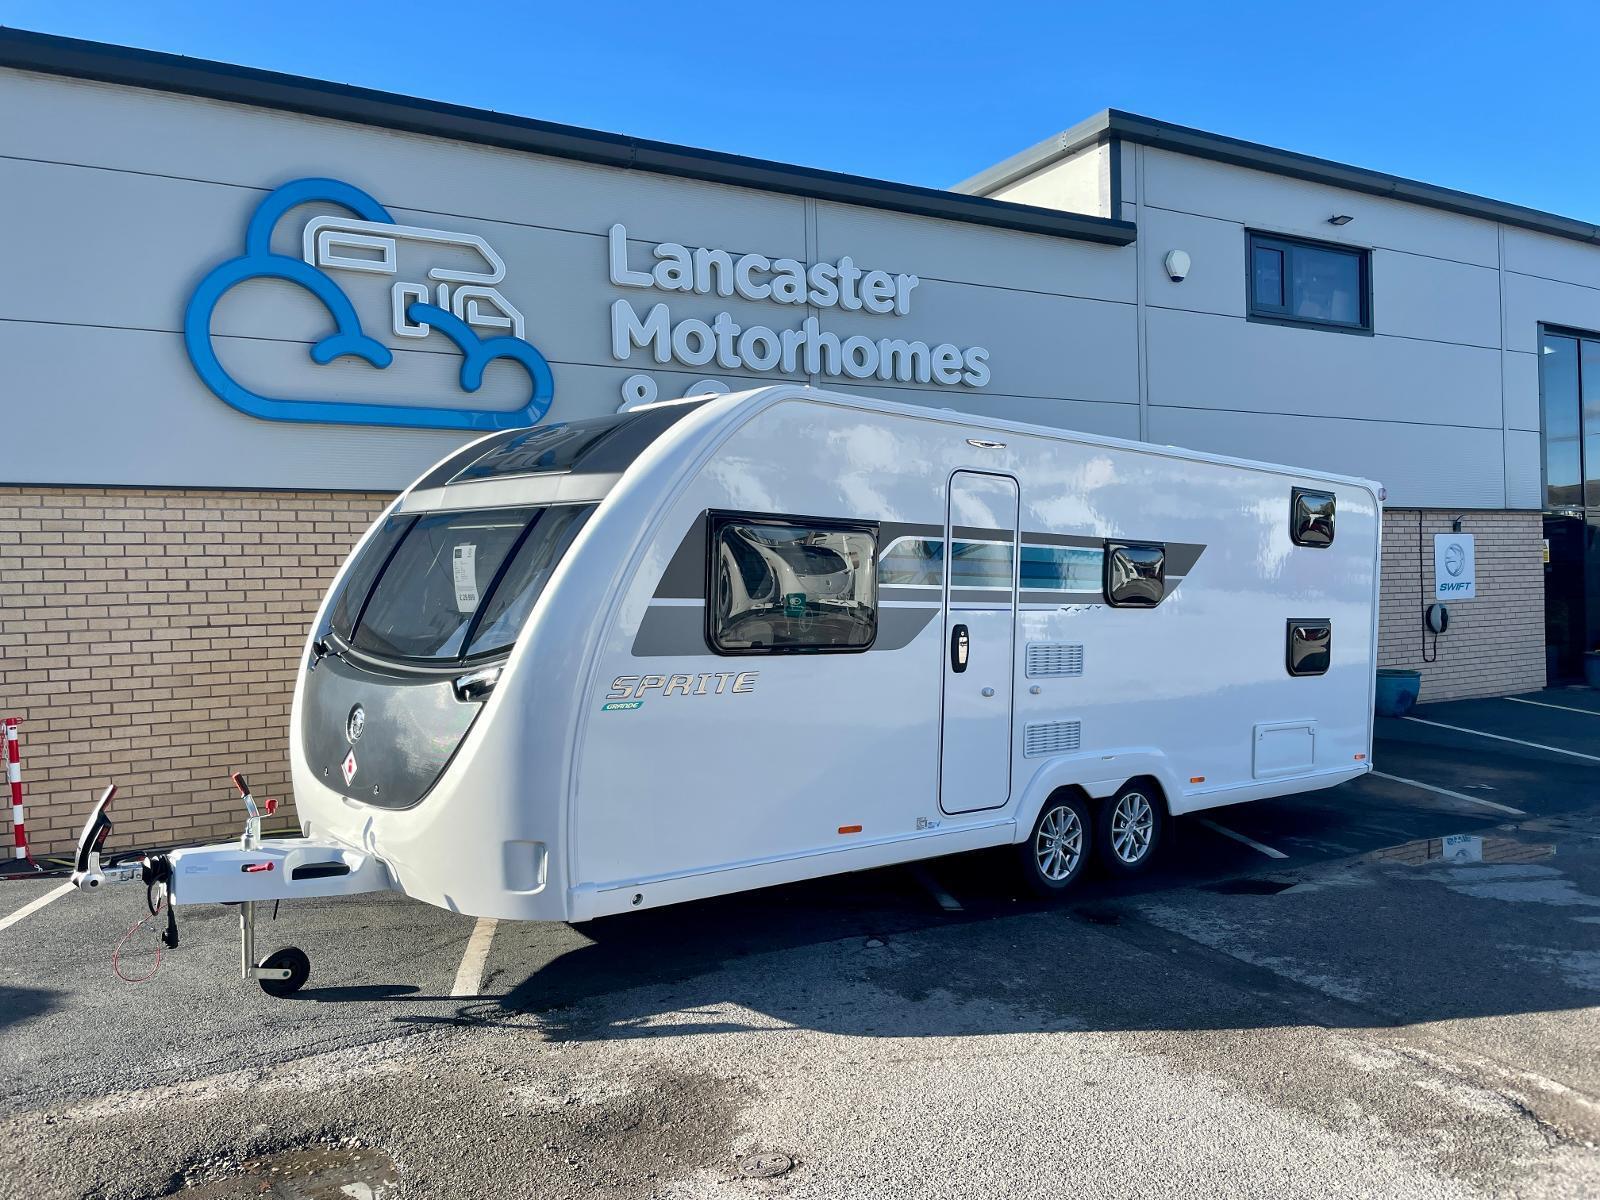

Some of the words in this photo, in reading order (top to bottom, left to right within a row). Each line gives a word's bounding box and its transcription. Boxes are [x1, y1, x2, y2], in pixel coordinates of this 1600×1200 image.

[609, 224, 919, 316] Lancaster
[611, 299, 991, 388] Motorhomes
[1439, 582, 1471, 591] SWIFT
[606, 671, 760, 699] SPRITE
[606, 702, 639, 710] GRANDE
